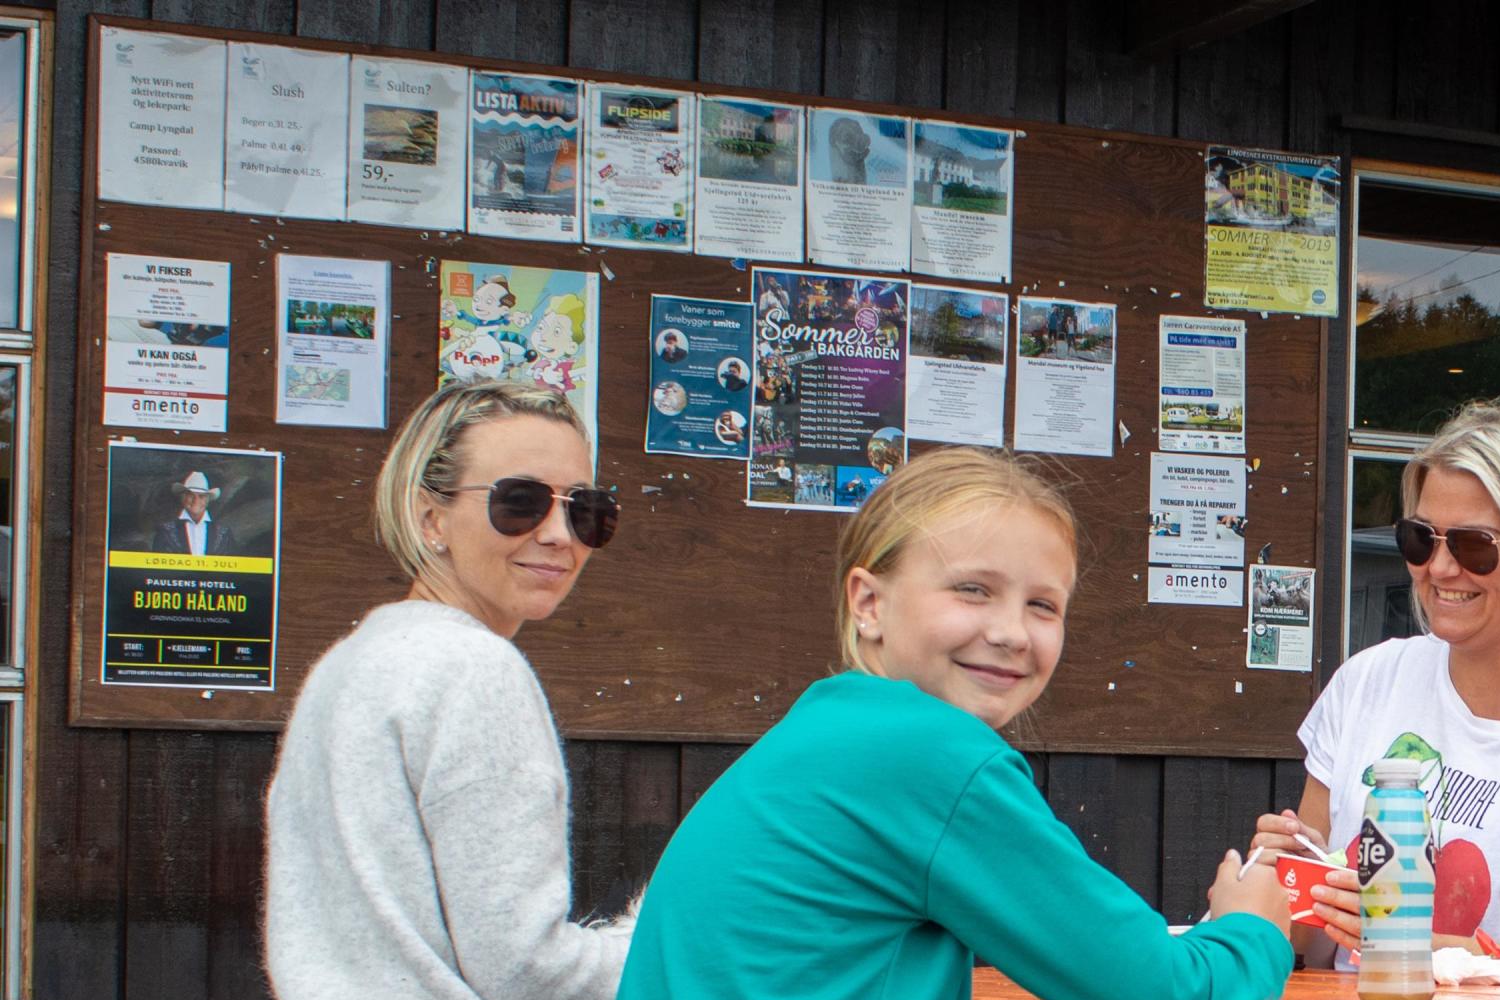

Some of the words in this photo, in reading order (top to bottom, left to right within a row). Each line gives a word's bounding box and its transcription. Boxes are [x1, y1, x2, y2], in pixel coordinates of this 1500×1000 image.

[152, 77, 174, 87] WiFi
[386, 80, 432, 96] Sulten?
[272, 84, 306, 99] Slush
[476, 91, 518, 111] LISTA
[607, 105, 673, 121] FLIPSIDE
[129, 121, 156, 132] Camp
[157, 123, 194, 135] Lyngdal
[362, 164, 394, 183] 59,-
[1209, 227, 1269, 245] SOMMER
[1299, 237, 1331, 252] 2019
[146, 265, 157, 274] VI
[158, 265, 192, 277] FIKSER
[680, 303, 706, 315] Vaner
[707, 308, 726, 317] som
[664, 314, 712, 328] forebygger
[712, 319, 741, 329] smitte
[761, 307, 875, 346] Sommer
[137, 349, 147, 358] VI
[149, 350, 169, 360] KAN
[171, 350, 198, 362] OGSÅ
[816, 341, 900, 361] BAKGÅRDEN
[132, 399, 199, 414] amento
[1167, 466, 1174, 474] VI
[1174, 467, 1196, 475] VASKER
[1196, 467, 1204, 476] OG
[1205, 468, 1231, 477] POLERER
[1159, 498, 1185, 507] TRENGER
[1185, 499, 1194, 507] DU
[1200, 499, 1208, 509] FÅ
[1208, 501, 1237, 510] REPARERT
[145, 558, 192, 567] LØRDAG
[213, 560, 239, 569] JULI
[146, 578, 197, 588] PAULSENS
[199, 580, 237, 589] HOTELL
[1165, 573, 1227, 589] amento
[133, 590, 182, 610] BJØRO
[186, 589, 248, 612] HÅLAND
